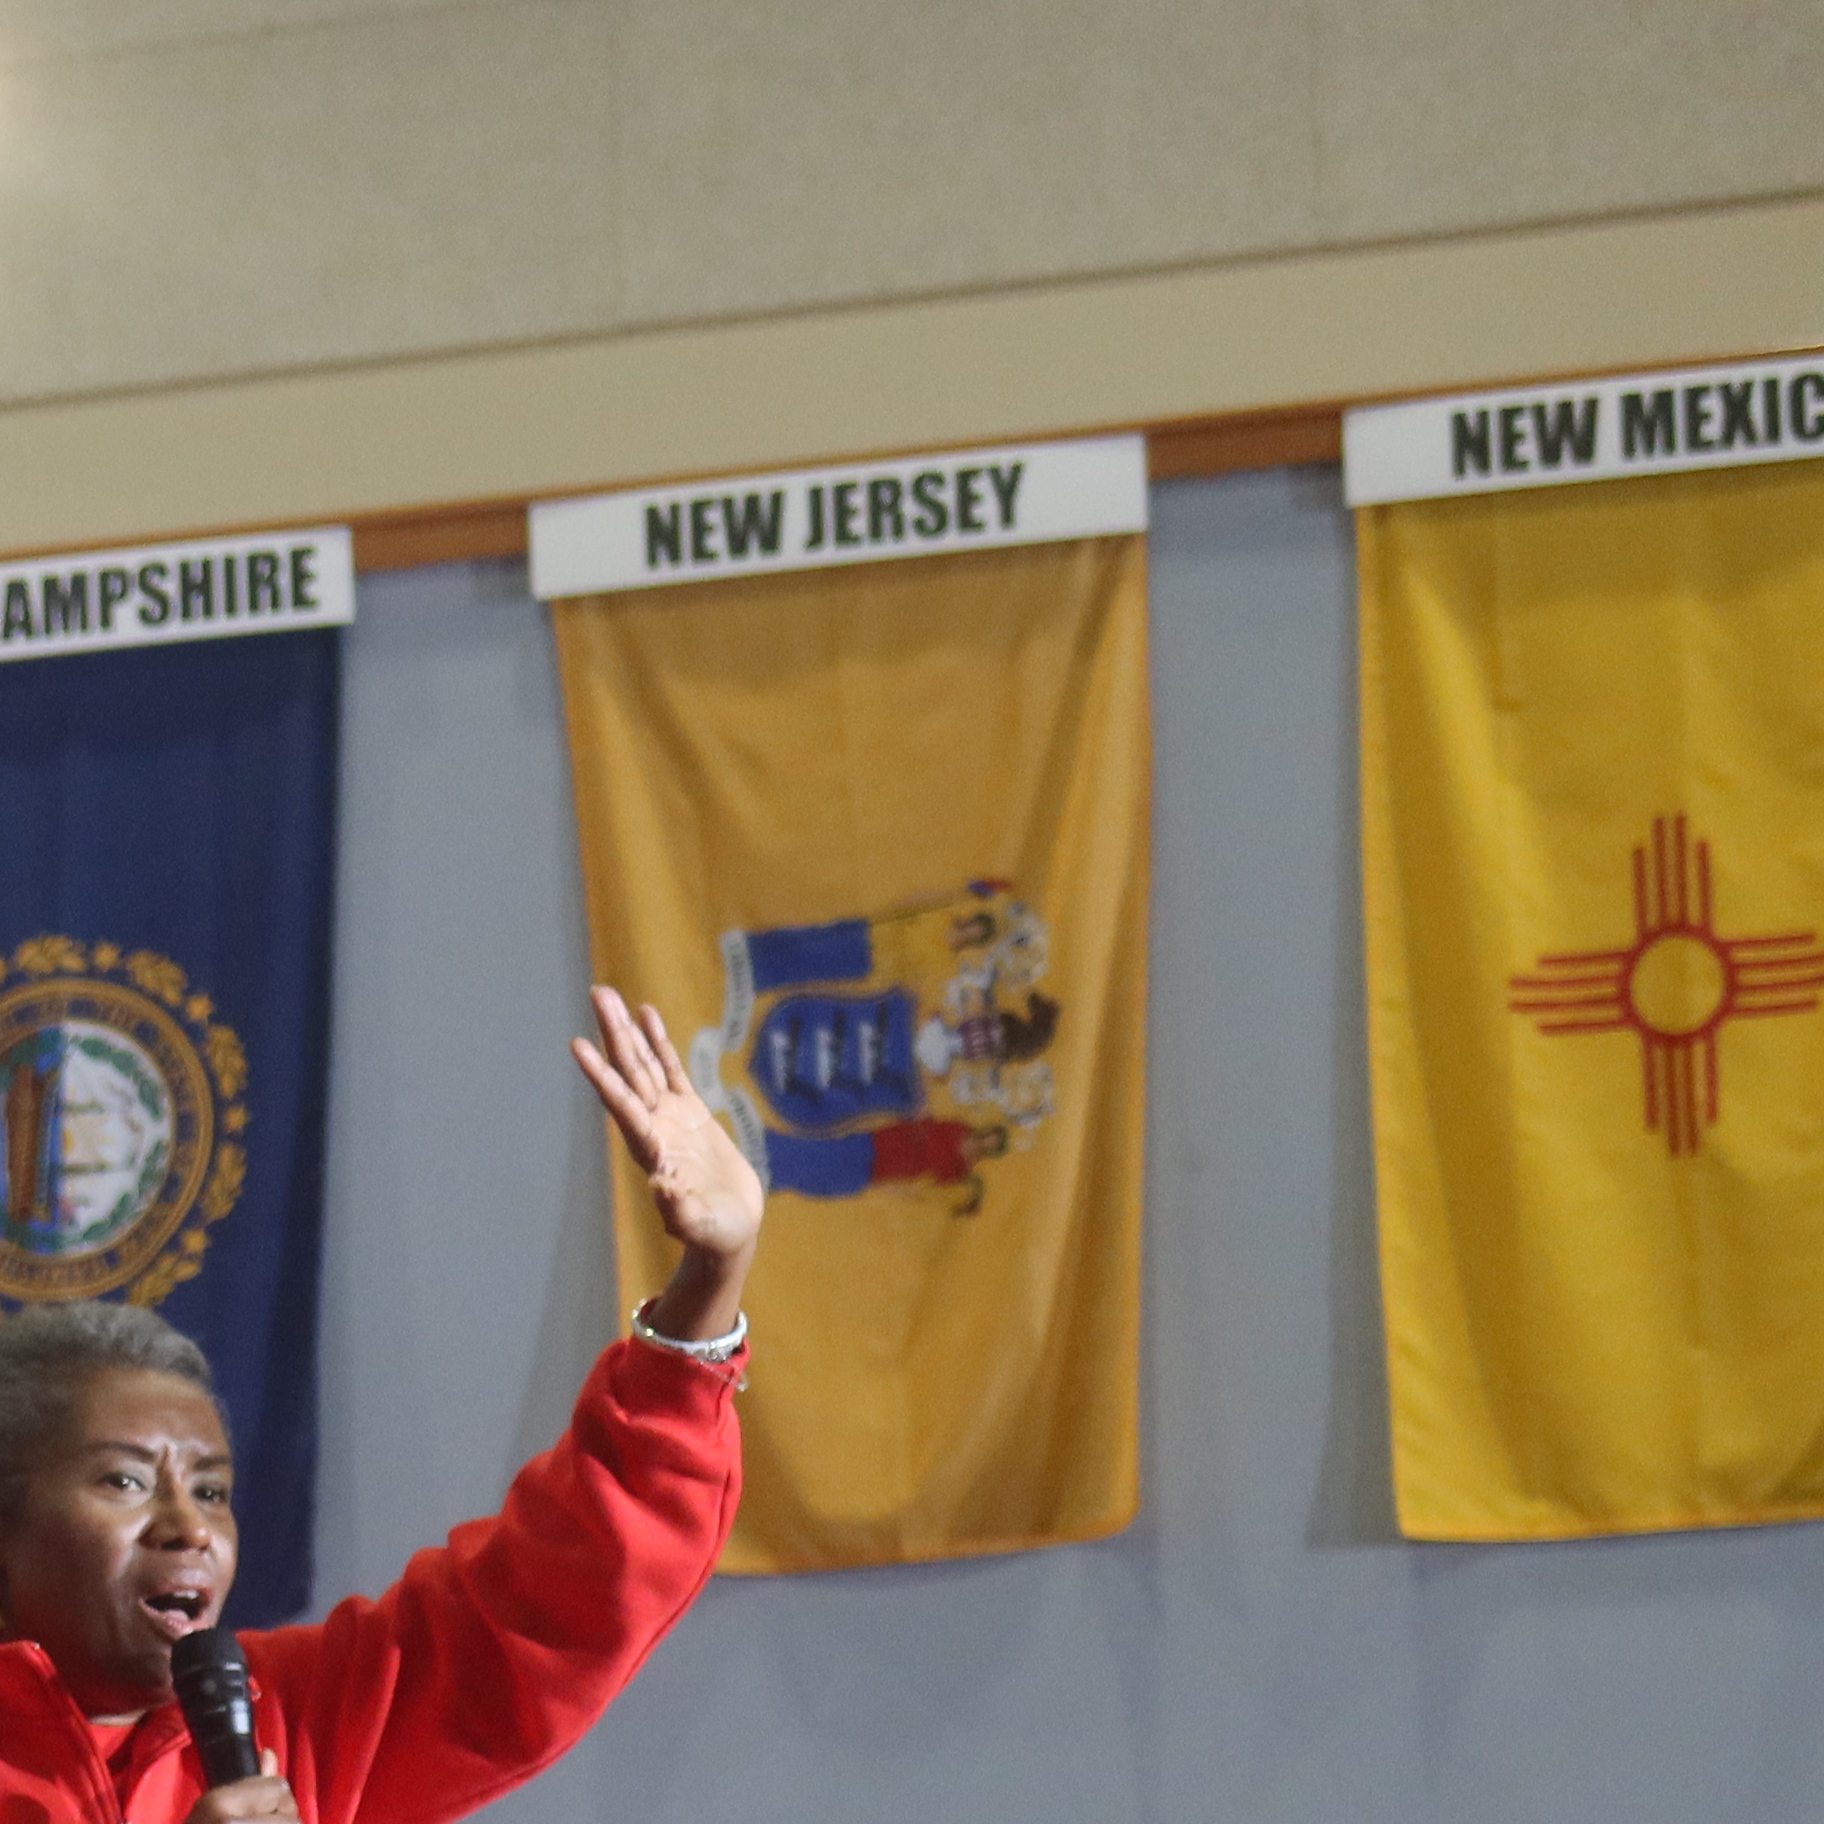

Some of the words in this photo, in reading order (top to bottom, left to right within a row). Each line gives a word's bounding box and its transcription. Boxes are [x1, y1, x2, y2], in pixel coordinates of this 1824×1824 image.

[1453, 396, 1598, 480] NEW
[1622, 371, 1824, 459] MEXIC
[645, 491, 785, 569] NEW
[805, 462, 1024, 550] JERSEY
